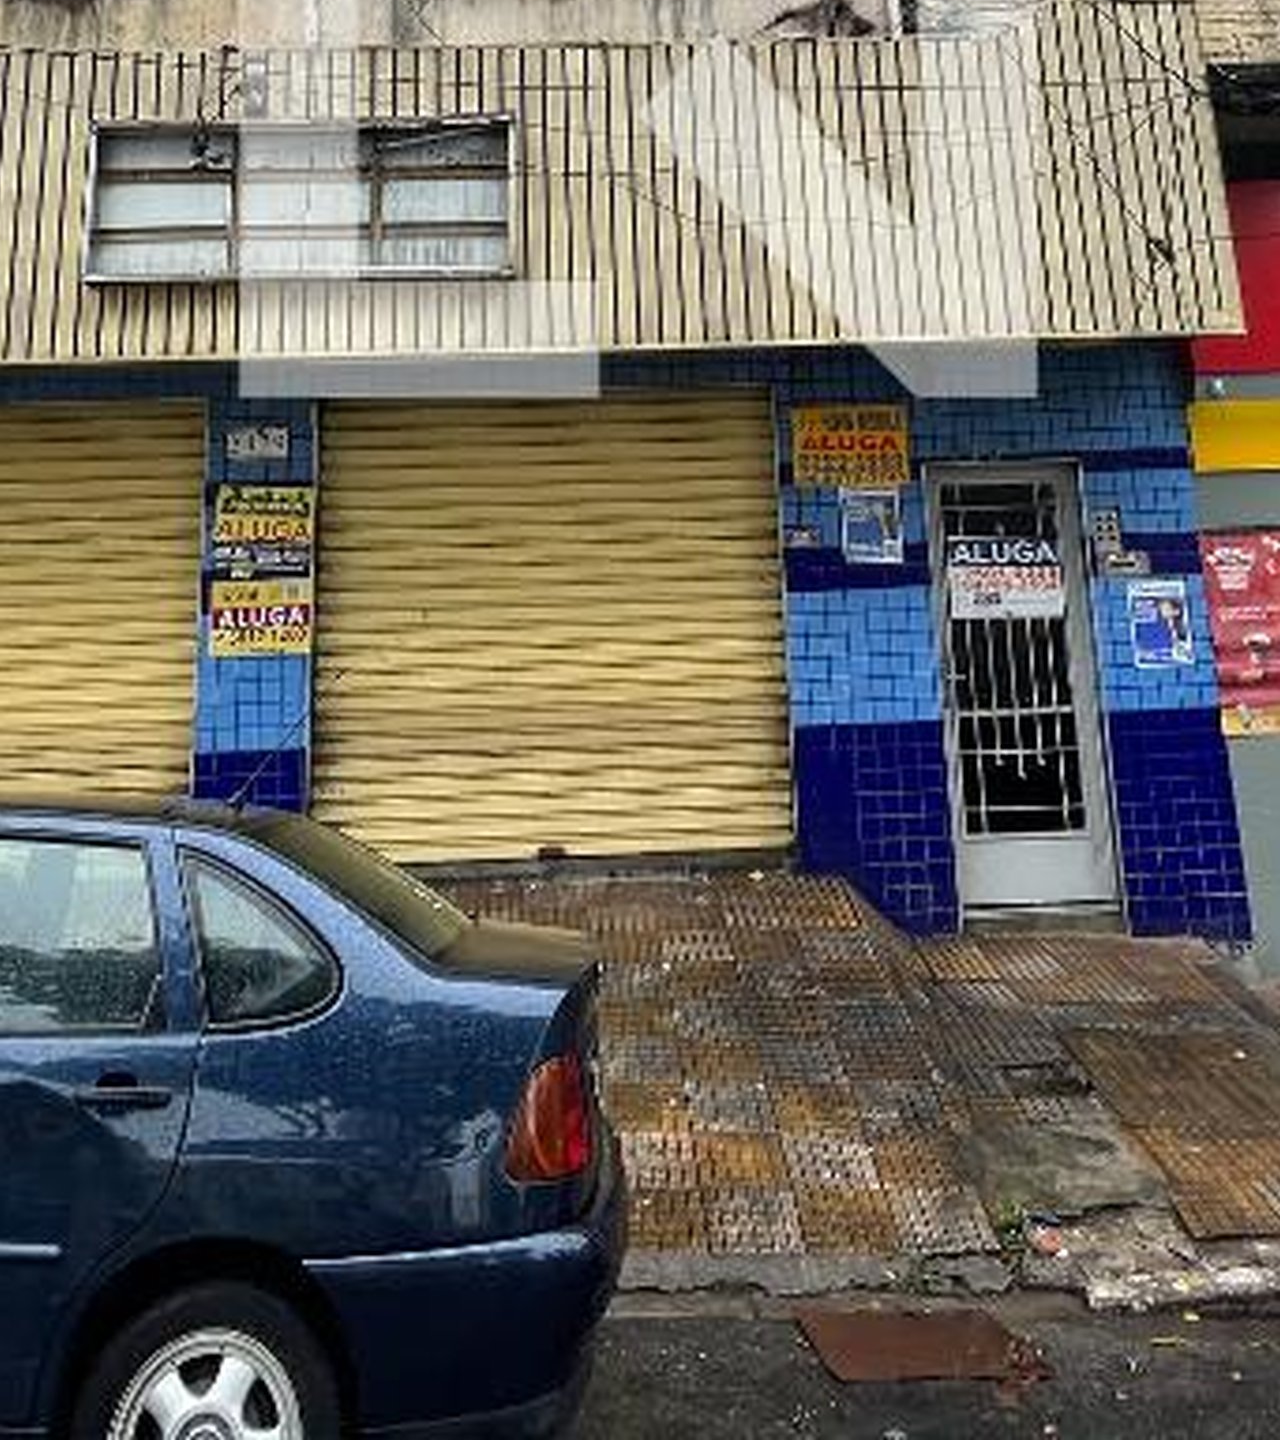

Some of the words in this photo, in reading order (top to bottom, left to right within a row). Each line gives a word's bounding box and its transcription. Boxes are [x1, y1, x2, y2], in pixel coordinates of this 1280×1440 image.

[799, 435, 898, 451] ALUGA
[215, 521, 310, 539] ALUGA
[951, 540, 1057, 563] ALUGA
[218, 606, 304, 629] ALUGA
